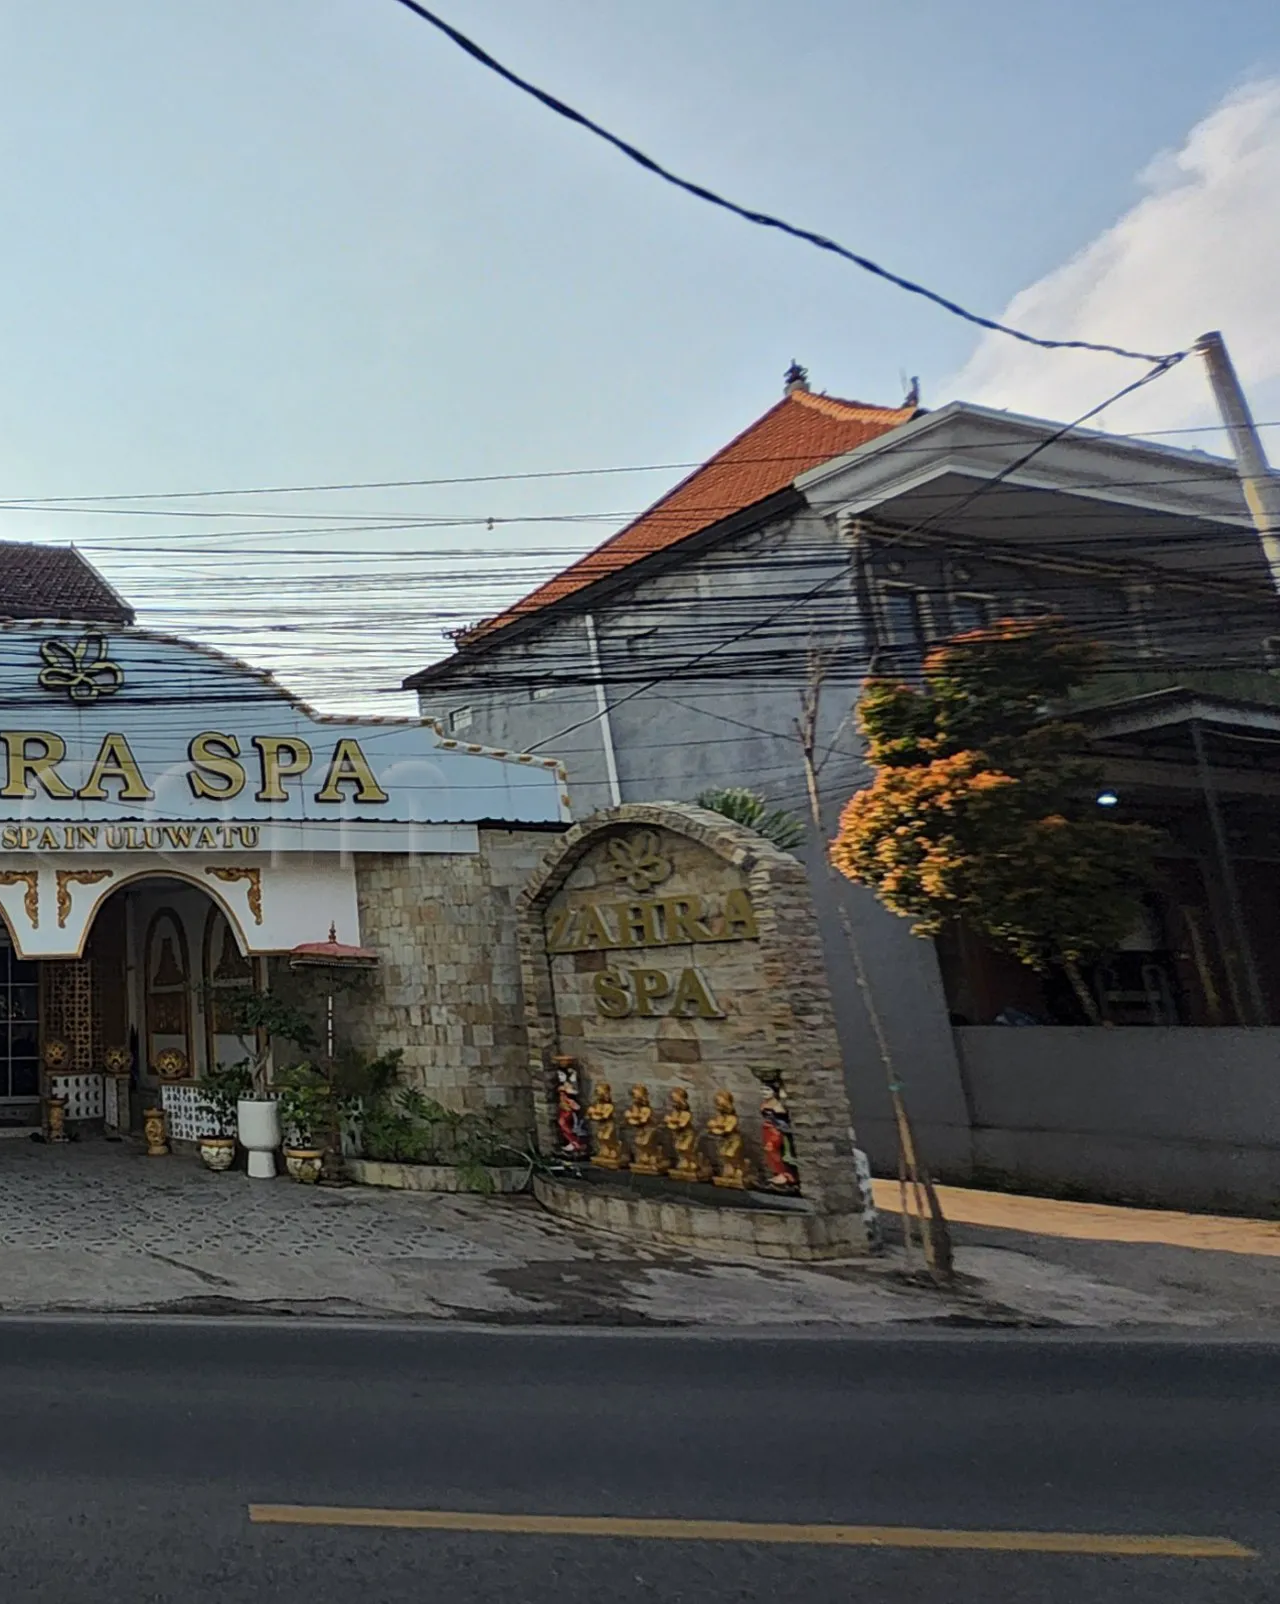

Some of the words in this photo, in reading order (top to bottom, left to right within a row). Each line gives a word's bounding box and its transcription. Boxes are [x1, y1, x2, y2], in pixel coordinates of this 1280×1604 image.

[186, 730, 390, 804] SPA
[104, 826, 260, 849] ULUWATU
[545, 889, 760, 954] ZAHRA
[592, 968, 727, 1019] SPA
